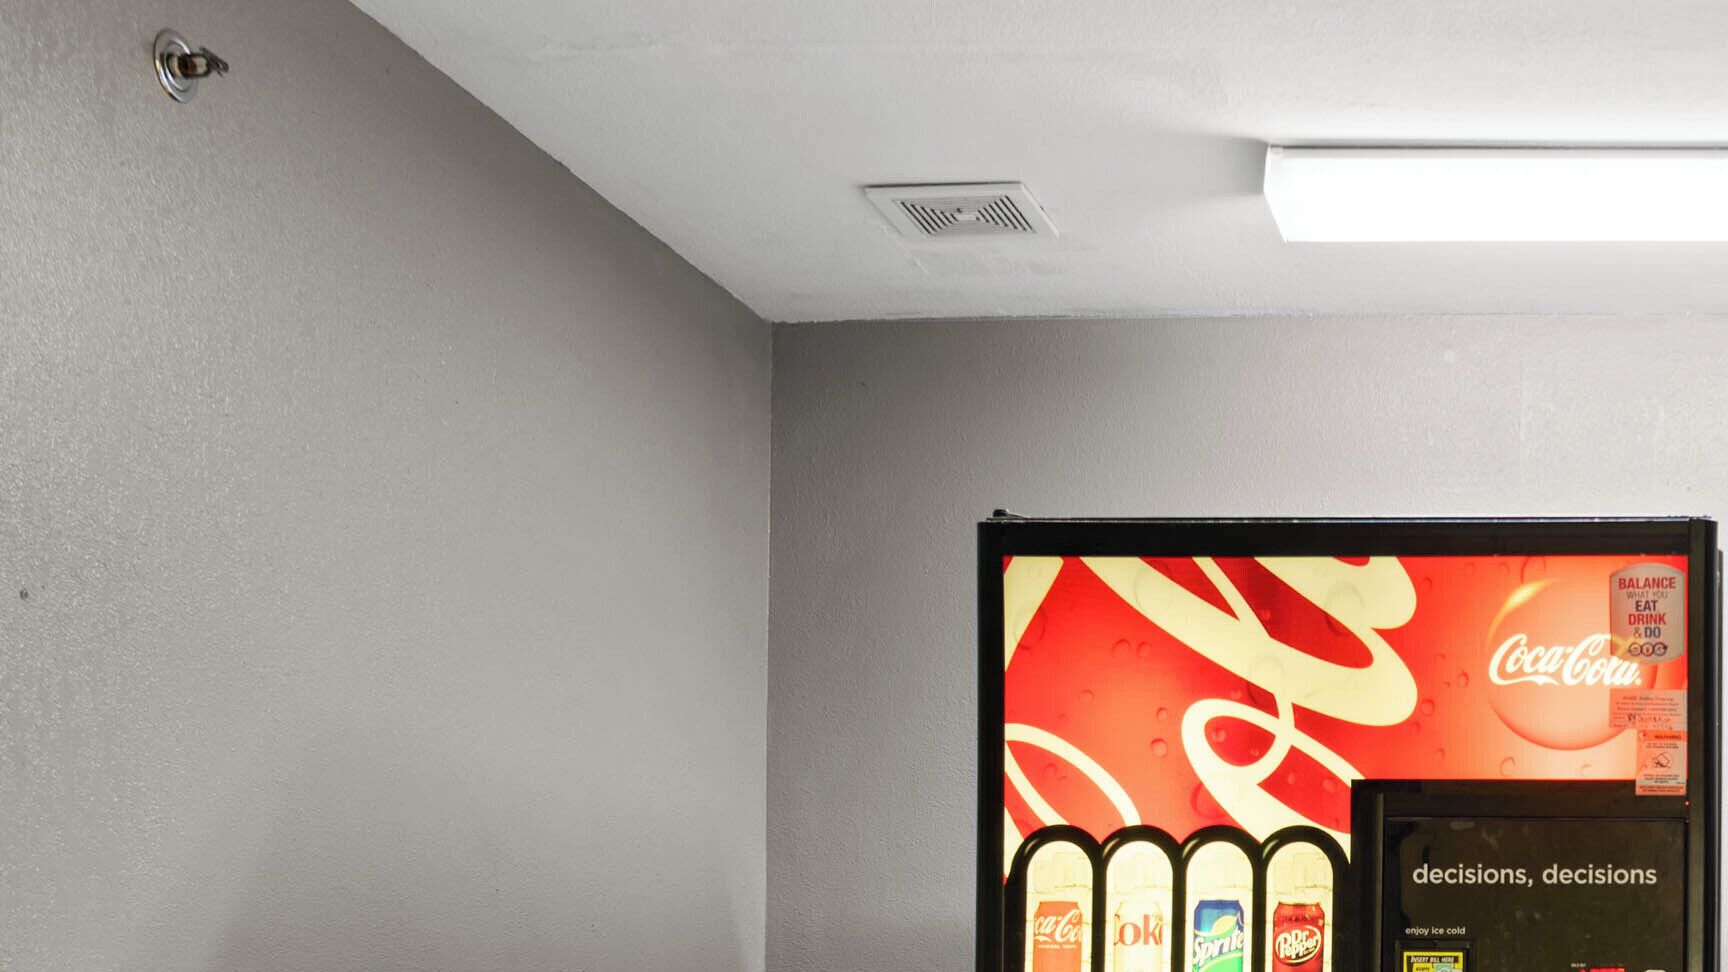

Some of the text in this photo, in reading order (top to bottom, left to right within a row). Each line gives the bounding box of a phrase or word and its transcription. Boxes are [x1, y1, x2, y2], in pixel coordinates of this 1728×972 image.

[1618, 576, 1676, 589] BALANCE
[1626, 590, 1668, 599] WHAT YOU
[1635, 600, 1657, 612] EAT
[1628, 613, 1666, 625] DRINK
[1633, 627, 1661, 638] & DO
[1412, 863, 1657, 887] decisions, decisions
[1405, 926, 1466, 935] enjoy ice cold
[1291, 929, 1309, 945] Dr
[1193, 926, 1244, 967] Sprite
[1279, 933, 1319, 959] Pepper
